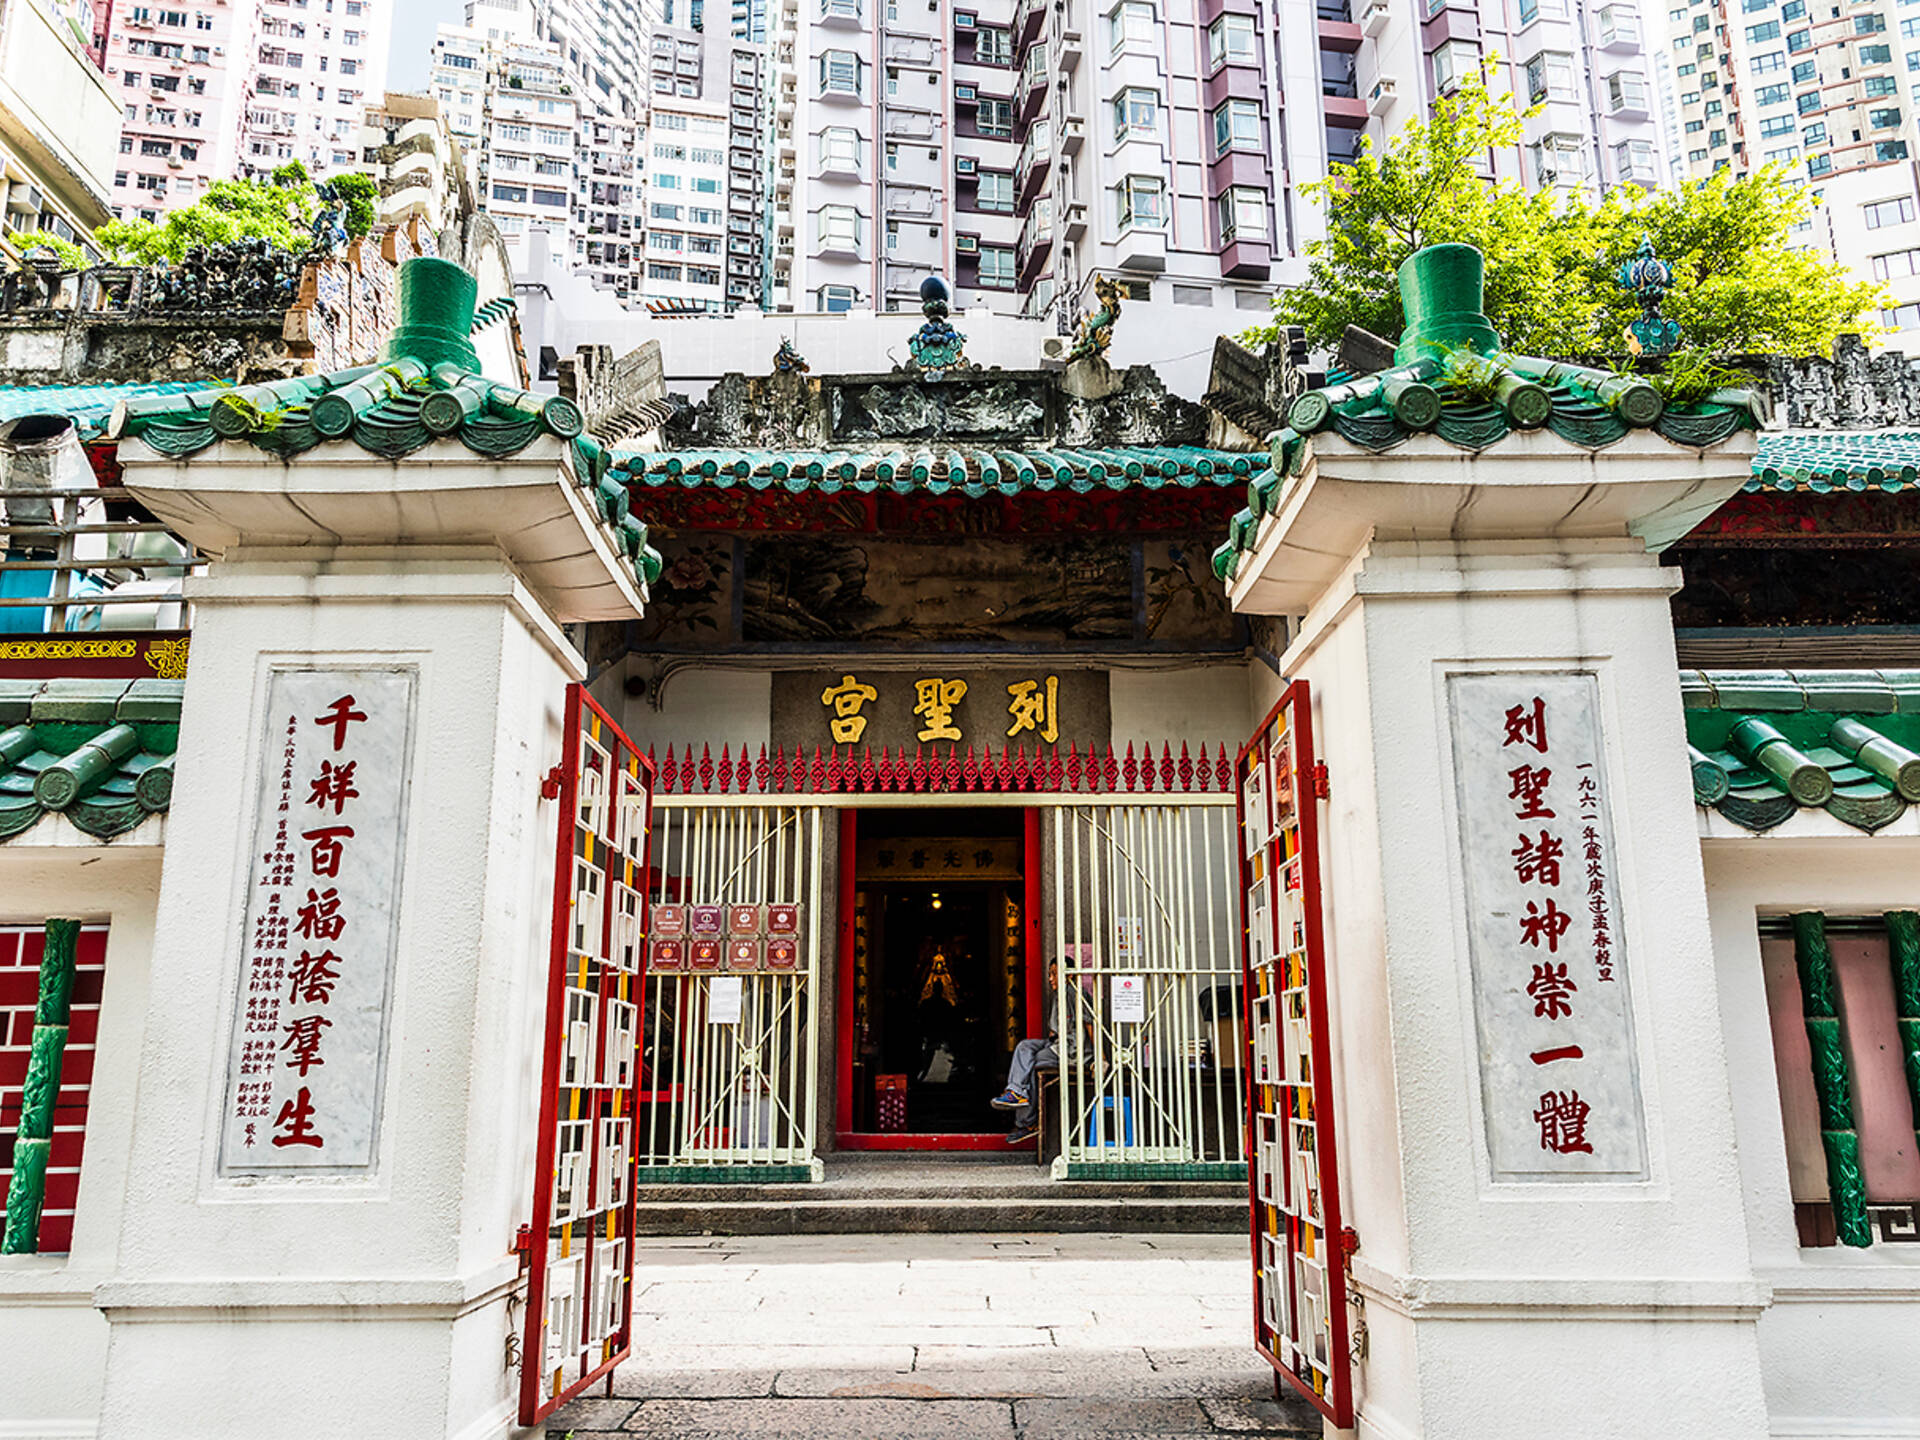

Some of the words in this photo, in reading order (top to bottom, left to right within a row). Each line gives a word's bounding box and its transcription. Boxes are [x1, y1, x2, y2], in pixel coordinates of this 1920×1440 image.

[821, 675, 1059, 744] 列聖宮
[1503, 696, 1593, 1155] 列聖諸神崇一體
